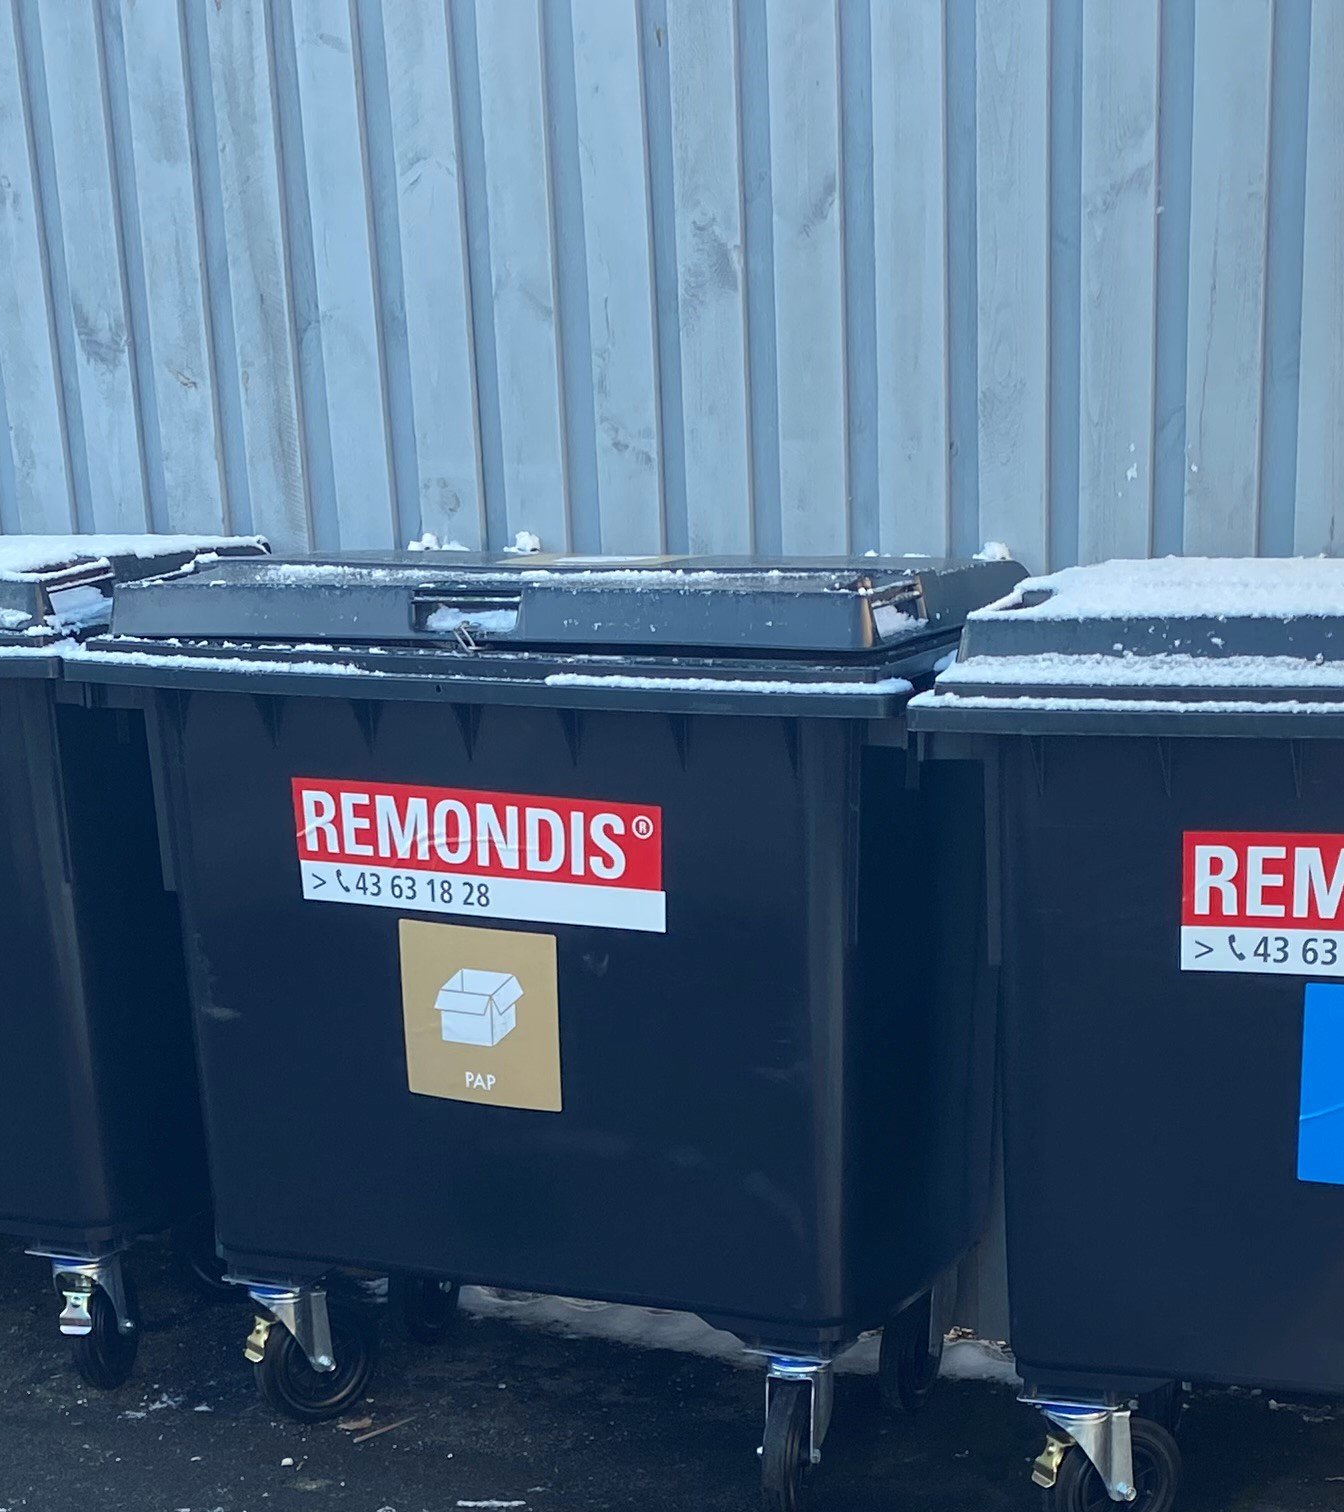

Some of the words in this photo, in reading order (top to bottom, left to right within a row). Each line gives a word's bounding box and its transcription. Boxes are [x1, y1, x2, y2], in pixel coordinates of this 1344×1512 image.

[355, 871, 382, 897] 43
[390, 874, 417, 900] 63
[426, 878, 453, 904] 18
[462, 881, 490, 908] 28
[1253, 935, 1290, 964] 43
[1301, 937, 1338, 967] 63
[465, 1071, 496, 1092] PAP
